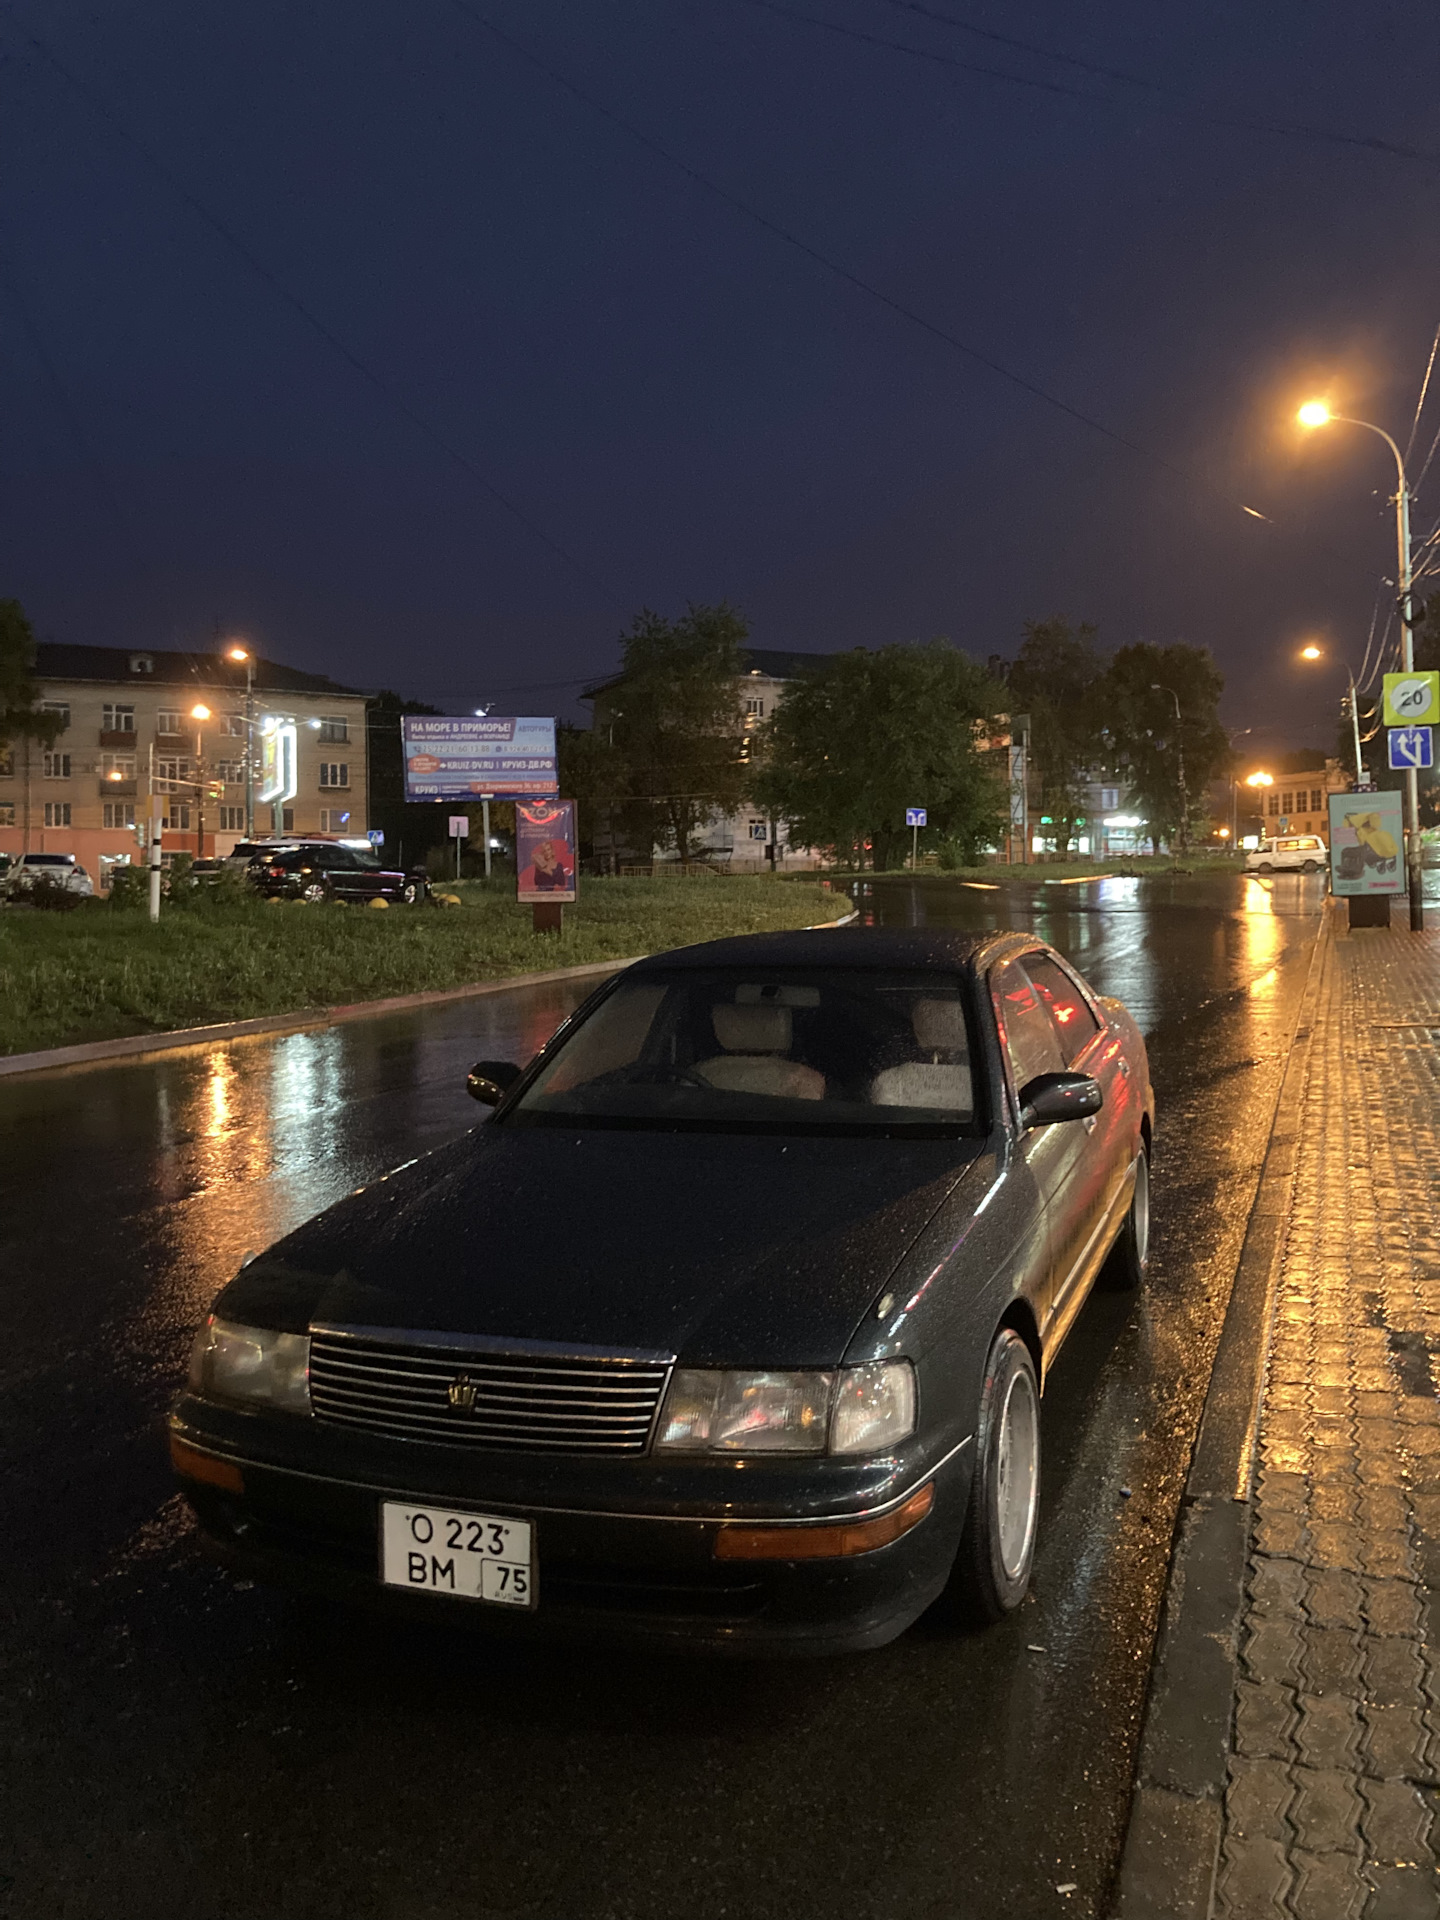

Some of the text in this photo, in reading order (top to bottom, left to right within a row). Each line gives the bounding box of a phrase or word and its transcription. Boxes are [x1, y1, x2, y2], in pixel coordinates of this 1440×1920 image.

[1401, 690, 1423, 707] 20
[411, 722, 511, 732] НА МОРЕ В ПРИМОРЬЕ!
[415, 785, 438, 794] КРУИЗ
[446, 1518, 504, 1556] 223
[408, 1551, 455, 1589] ВМ
[497, 1566, 527, 1593] 75
